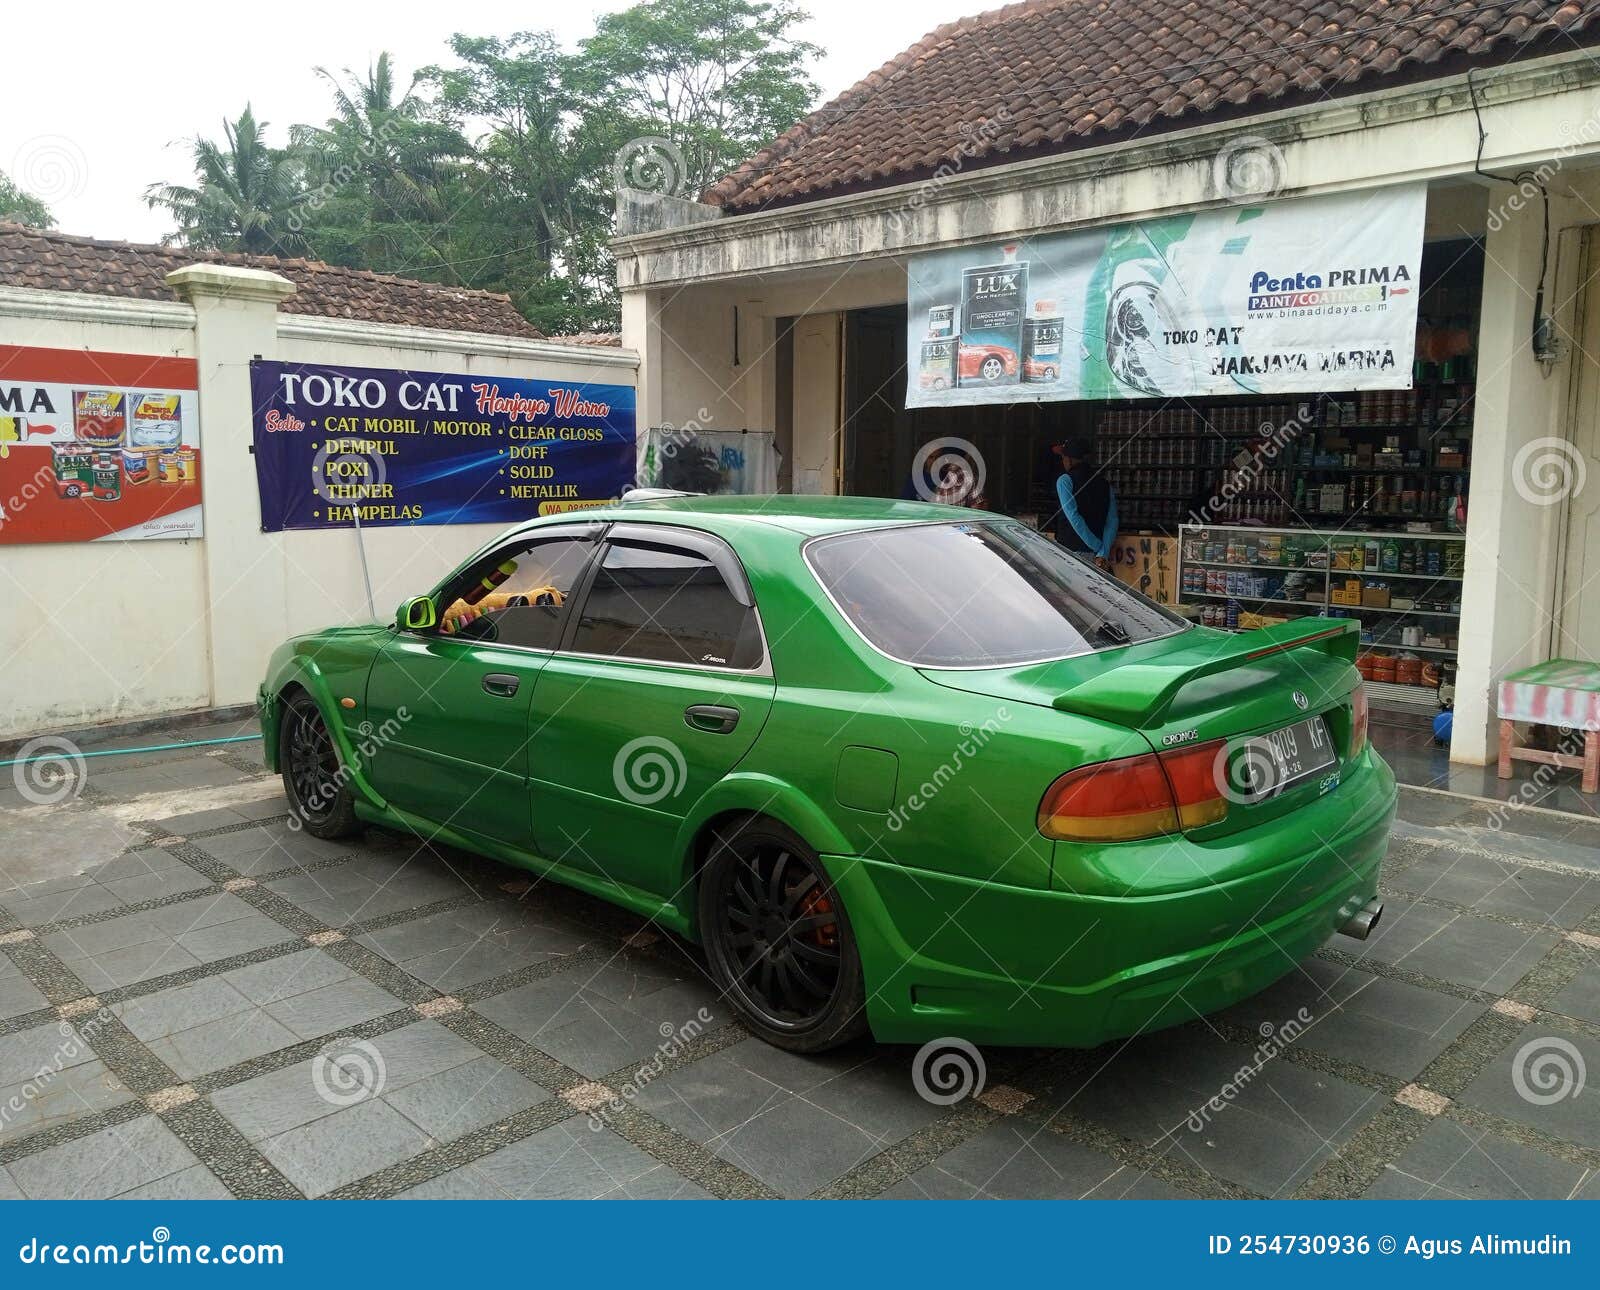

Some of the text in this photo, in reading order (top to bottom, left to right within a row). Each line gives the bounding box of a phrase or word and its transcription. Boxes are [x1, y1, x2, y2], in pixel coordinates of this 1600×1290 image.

[975, 274, 1018, 294] LUX
[1250, 265, 1411, 293] Penta PRIMA
[1248, 304, 1387, 320] www.binaadidaya.cm
[1033, 327, 1062, 341] LUX
[1163, 329, 1198, 345] TOKO
[1210, 355, 1308, 376] HANJAYA
[280, 374, 611, 422] TOKO CAT Hanjaya Warna
[265, 409, 306, 432] Sedia
[324, 416, 359, 432] CAT
[364, 418, 420, 434] MOBIL
[433, 421, 492, 436] MOTOR
[509, 425, 604, 441] CLEAR GLOSS
[325, 439, 399, 455] DEMPUL
[509, 446, 548, 459] DOFF
[325, 461, 369, 477] POXI
[509, 465, 554, 479] SOLID
[326, 483, 394, 499] THINER
[510, 485, 578, 498] METALLIK
[327, 504, 423, 521] HAMPELAS
[545, 504, 562, 515] WA
[1162, 729, 1198, 746] CRONOS
[1266, 727, 1298, 766] 1809
[1307, 717, 1324, 749] KF
